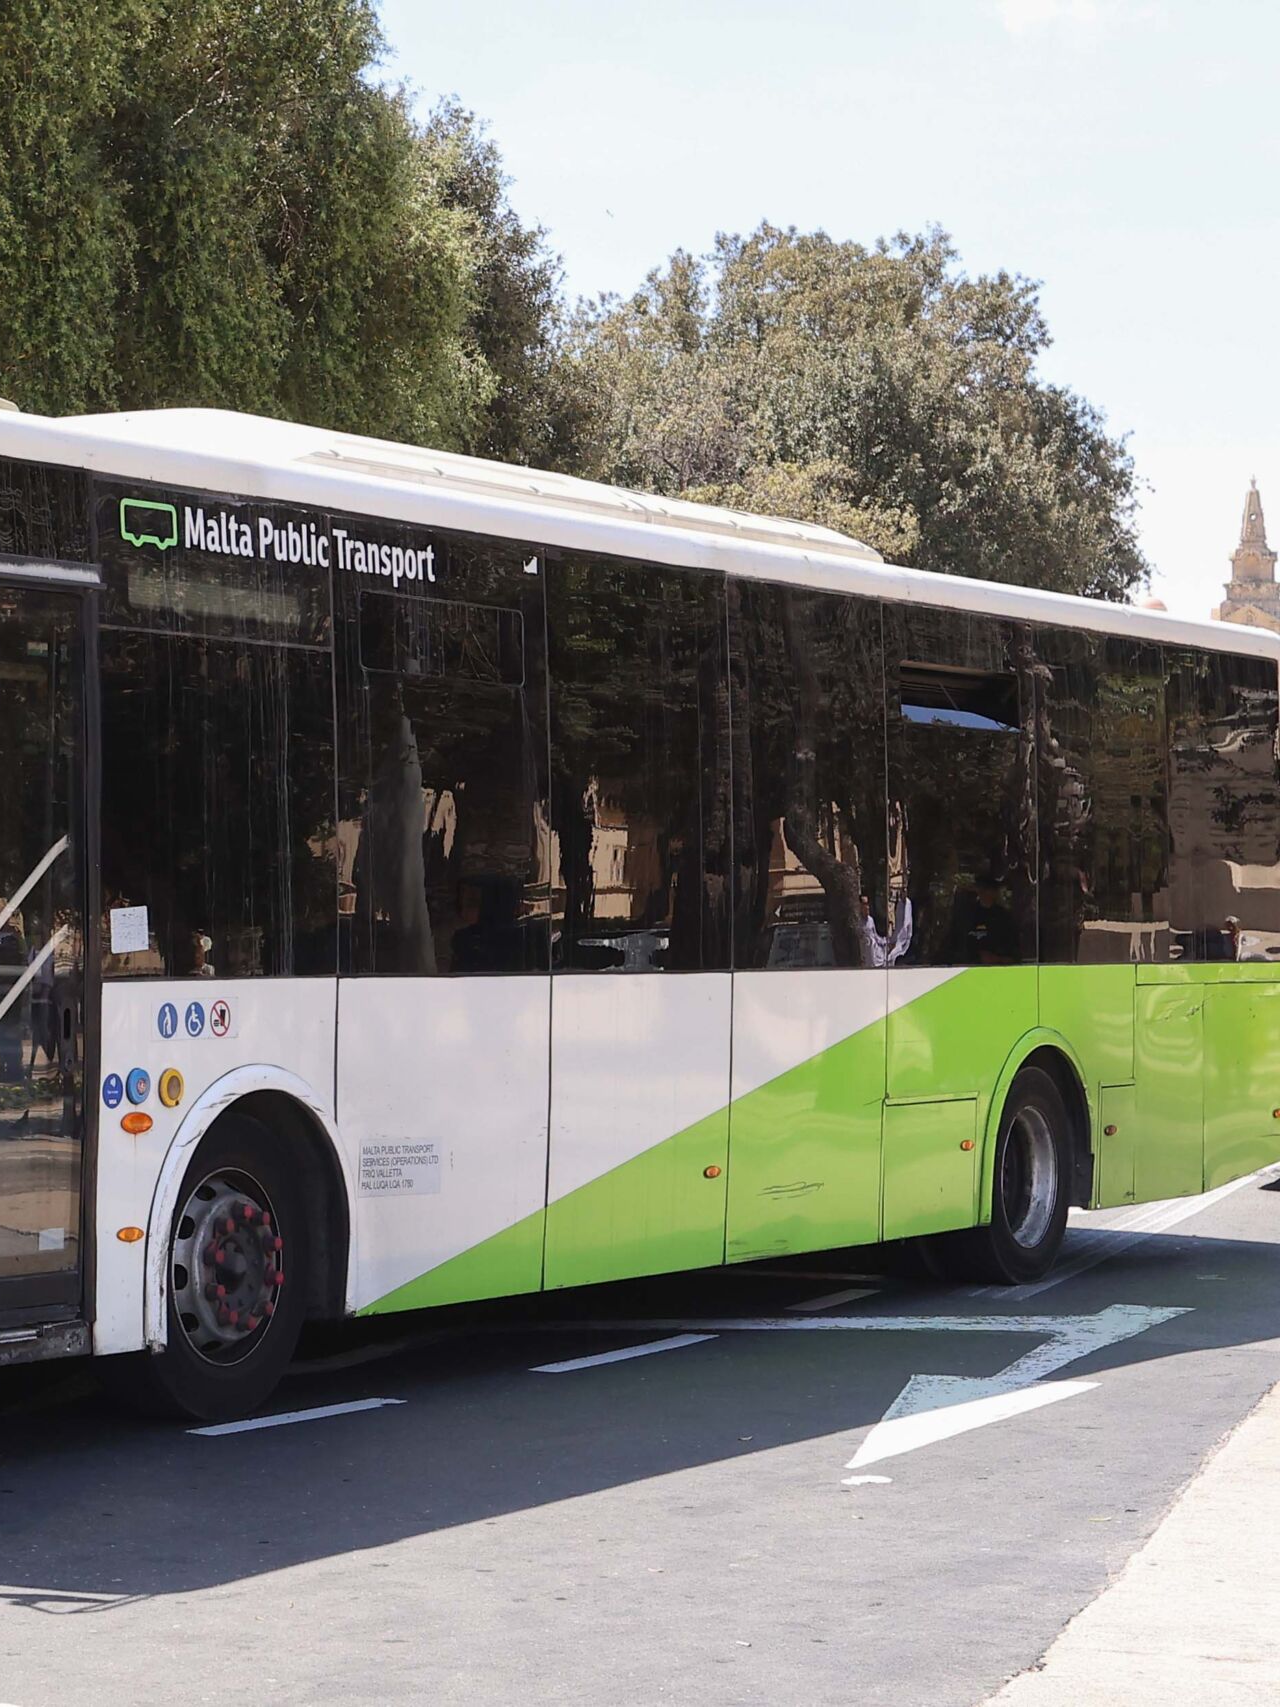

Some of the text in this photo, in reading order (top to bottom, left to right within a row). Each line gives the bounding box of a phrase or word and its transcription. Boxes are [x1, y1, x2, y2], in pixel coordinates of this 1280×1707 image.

[185, 507, 435, 587] Malta Public Transport
[362, 1144, 434, 1155] MALTA PUBLIC TRANSPORT
[362, 1157, 390, 1167] SERVICES
[428, 1155, 439, 1164] LTD
[361, 1168, 403, 1178] TRIQ VALLETTA
[373, 1180, 389, 1189] LUQA
